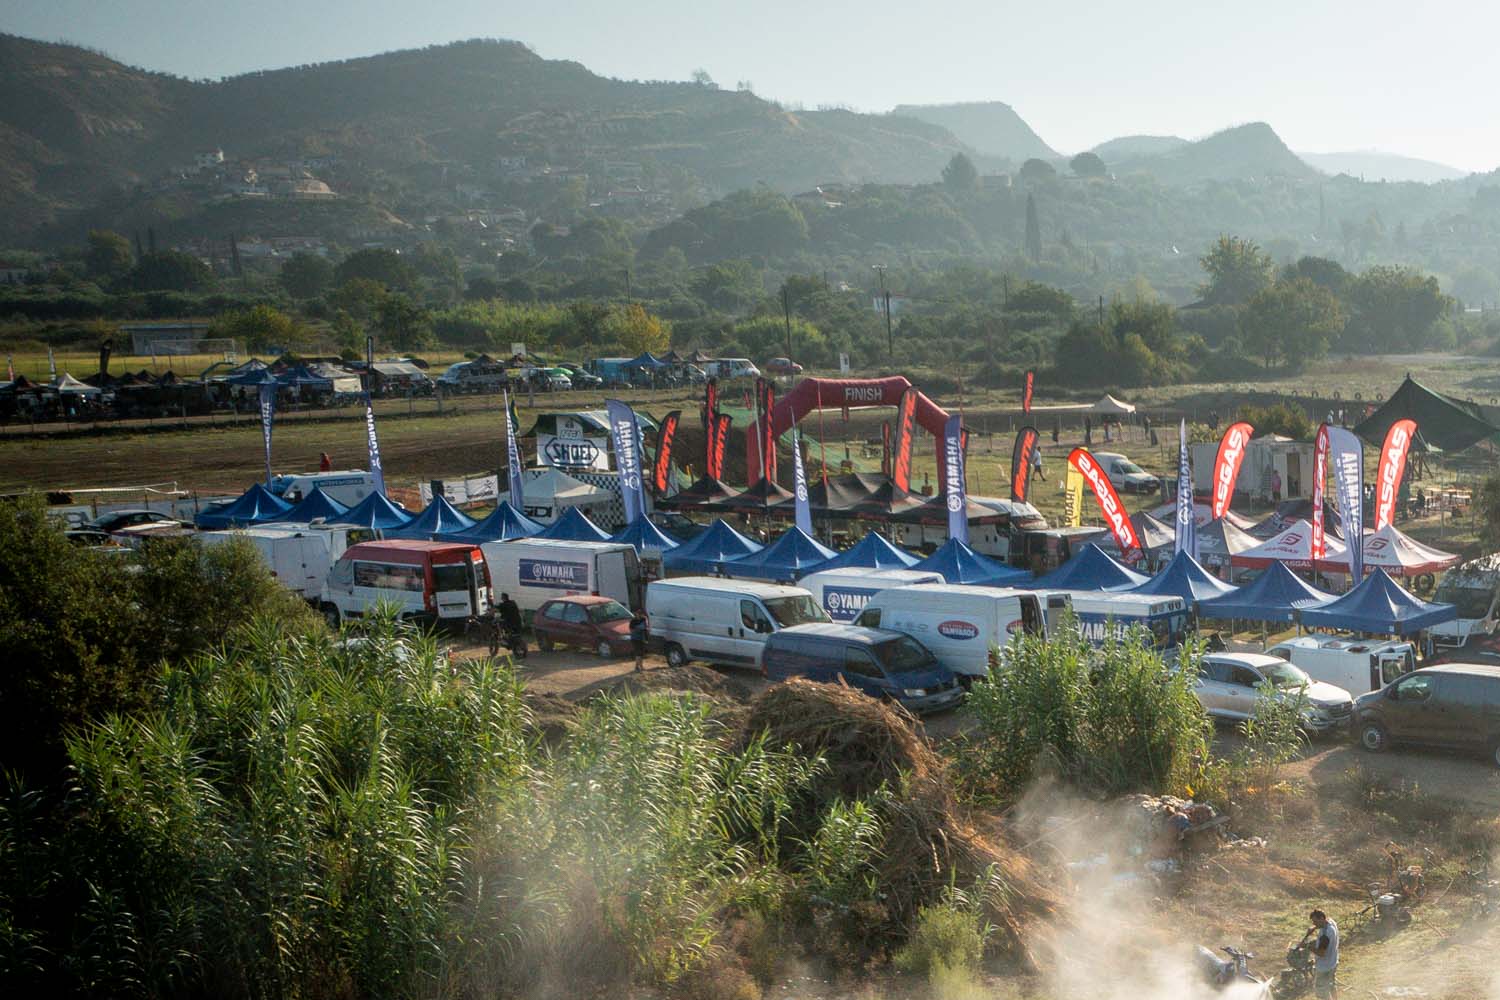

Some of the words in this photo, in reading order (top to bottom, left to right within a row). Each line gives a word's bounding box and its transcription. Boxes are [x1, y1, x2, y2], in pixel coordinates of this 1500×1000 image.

[845, 387, 882, 401] FINISH
[552, 443, 592, 461] SHOEI
[946, 436, 957, 493] YAMAHA
[542, 565, 574, 579] YAMAHA
